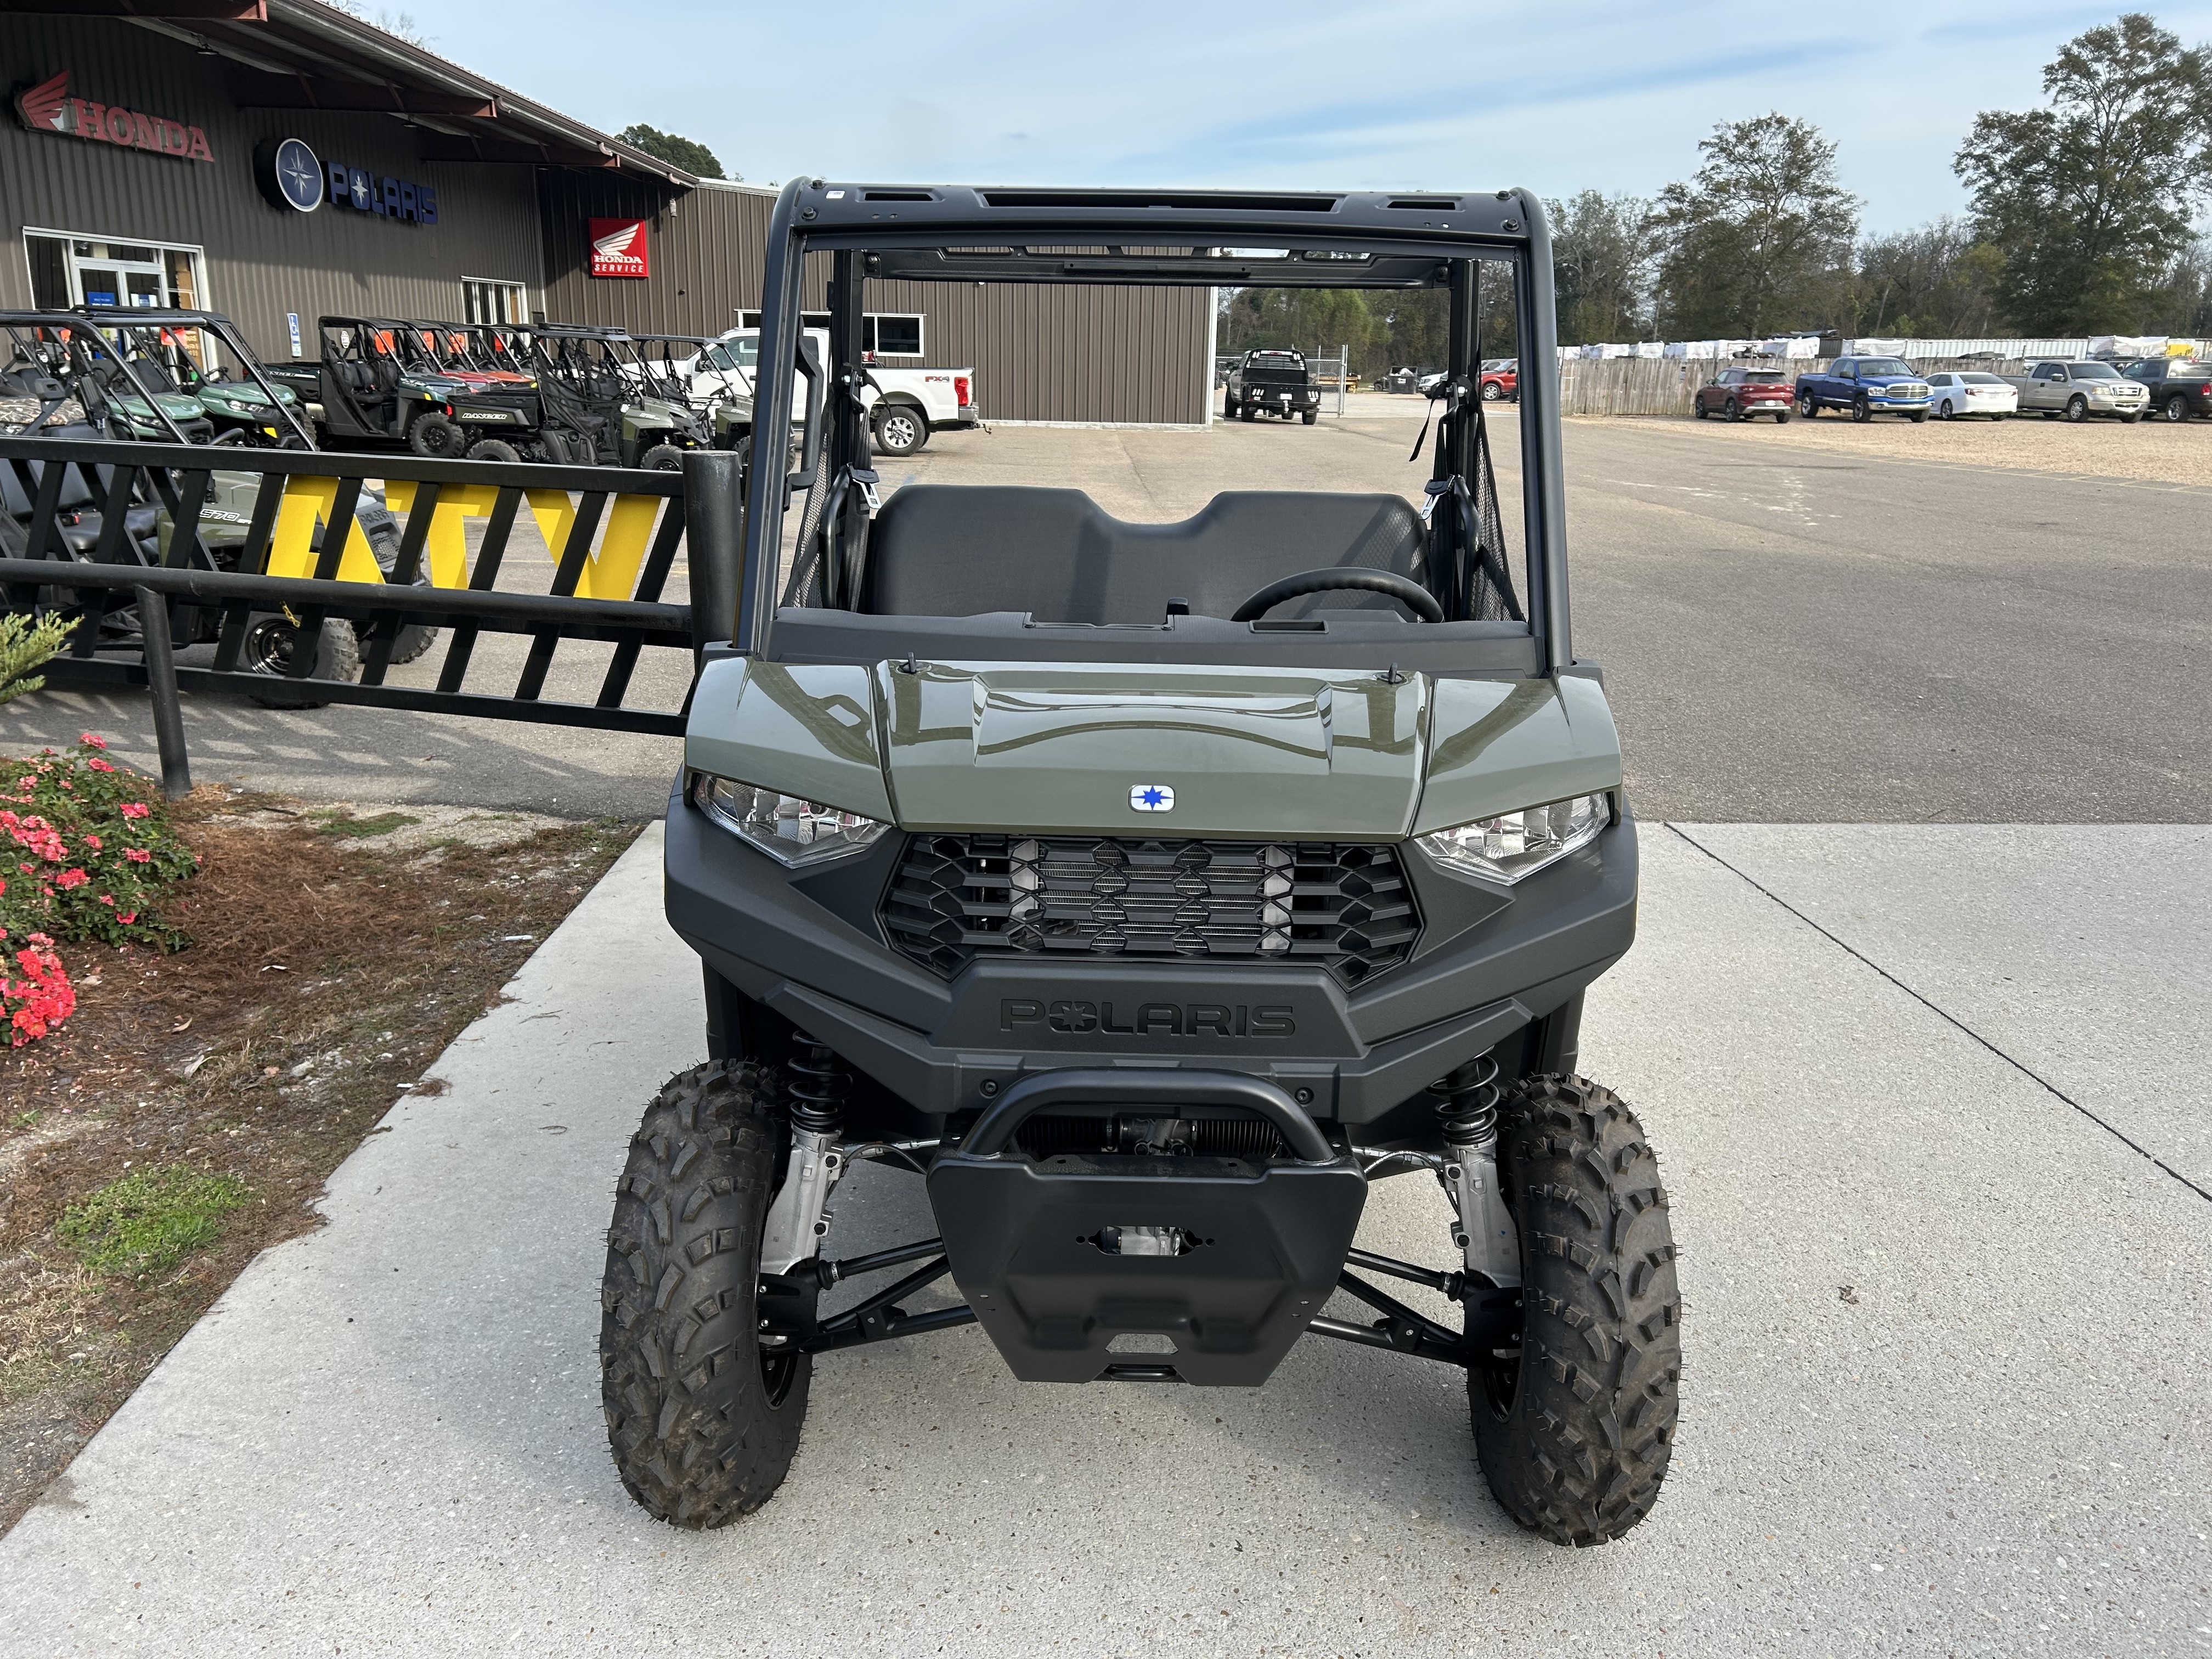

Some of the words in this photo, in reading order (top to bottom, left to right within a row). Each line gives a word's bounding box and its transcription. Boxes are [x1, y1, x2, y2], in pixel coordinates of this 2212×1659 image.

[71, 98, 215, 162] HONDA
[328, 162, 438, 225] POLARIS
[594, 255, 644, 264] HONDA
[594, 264, 644, 273] SERVICE
[199, 508, 240, 522] 570
[1001, 998, 1295, 1039] POLARIS
